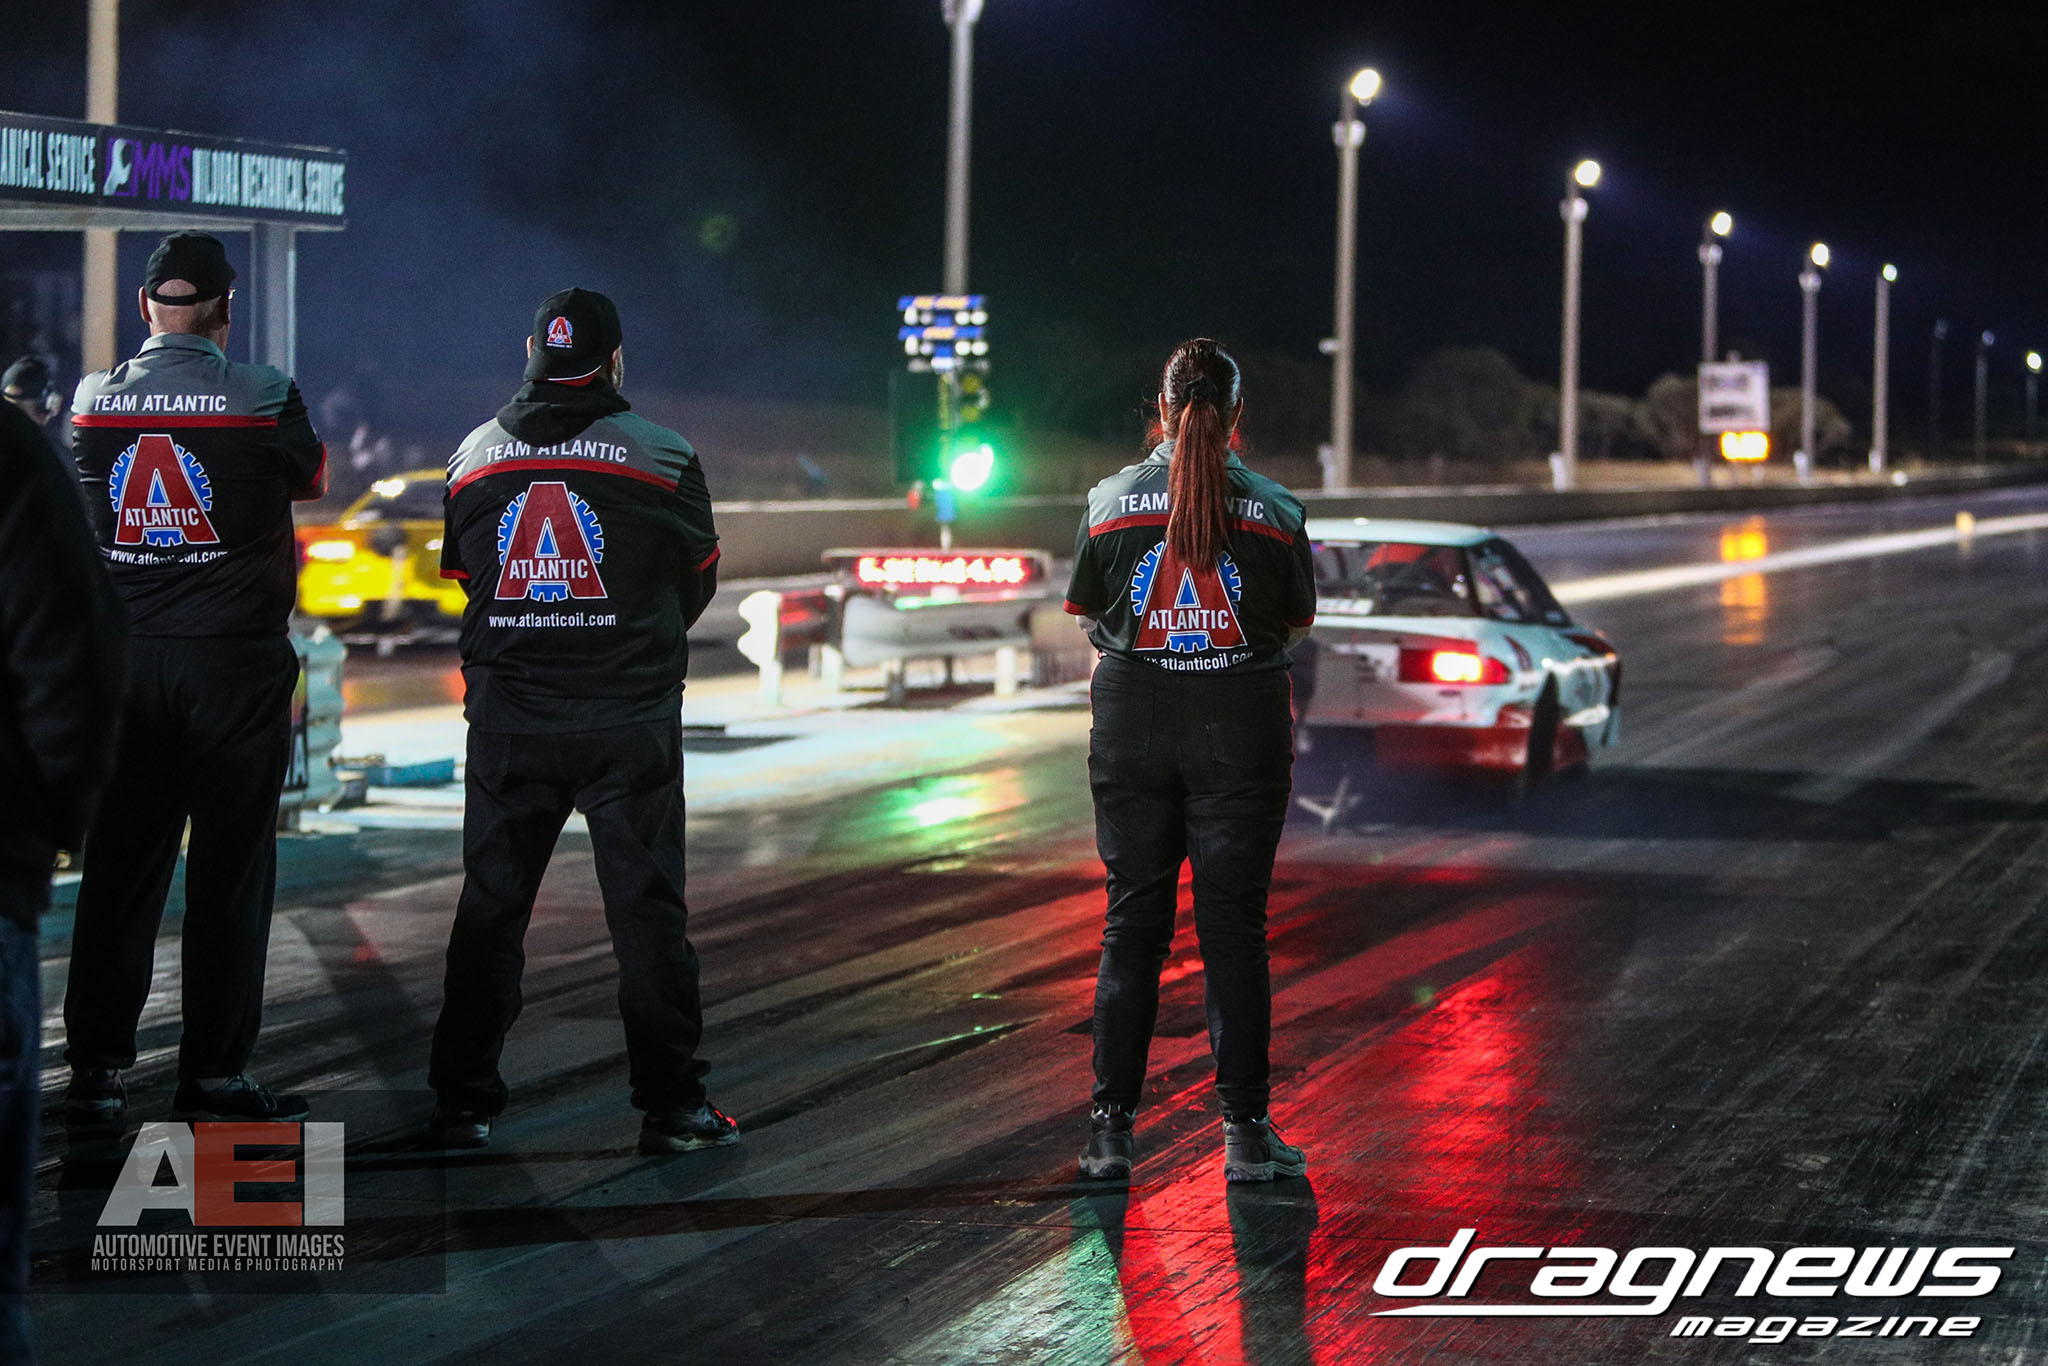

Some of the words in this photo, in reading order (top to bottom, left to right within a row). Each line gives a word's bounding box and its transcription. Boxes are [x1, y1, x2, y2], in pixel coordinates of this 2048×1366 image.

[0, 127, 44, 189] ANICAL
[46, 131, 96, 194] SERVICE
[94, 394, 137, 412] TEAM
[142, 394, 227, 412] ATLANTIC
[485, 441, 531, 463] TEAM
[1119, 492, 1169, 513] TEAM
[125, 507, 200, 527] ATLANTIC
[508, 558, 589, 580] ATLANTIC
[489, 612, 617, 628] www.atlanticoil.com
[1148, 609, 1230, 630] ATLANTIC
